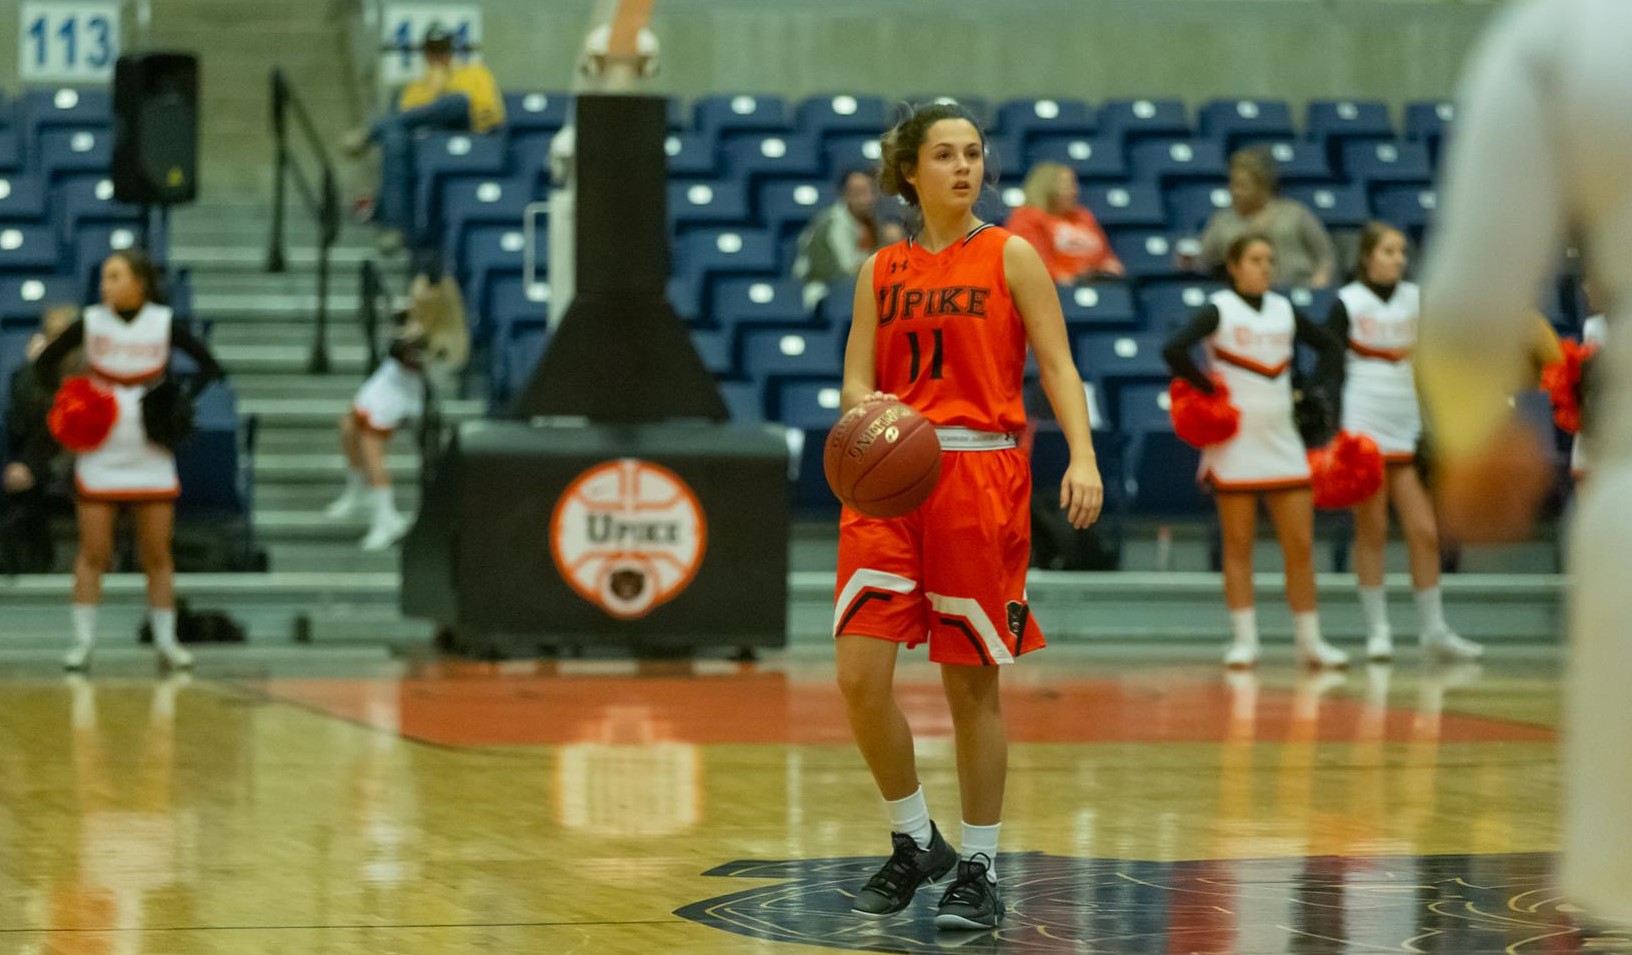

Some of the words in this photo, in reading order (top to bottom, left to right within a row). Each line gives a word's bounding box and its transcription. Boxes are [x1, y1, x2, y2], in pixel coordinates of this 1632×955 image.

[28, 16, 112, 67] 113
[879, 281, 990, 327] UPIKE
[906, 328, 943, 383] 11
